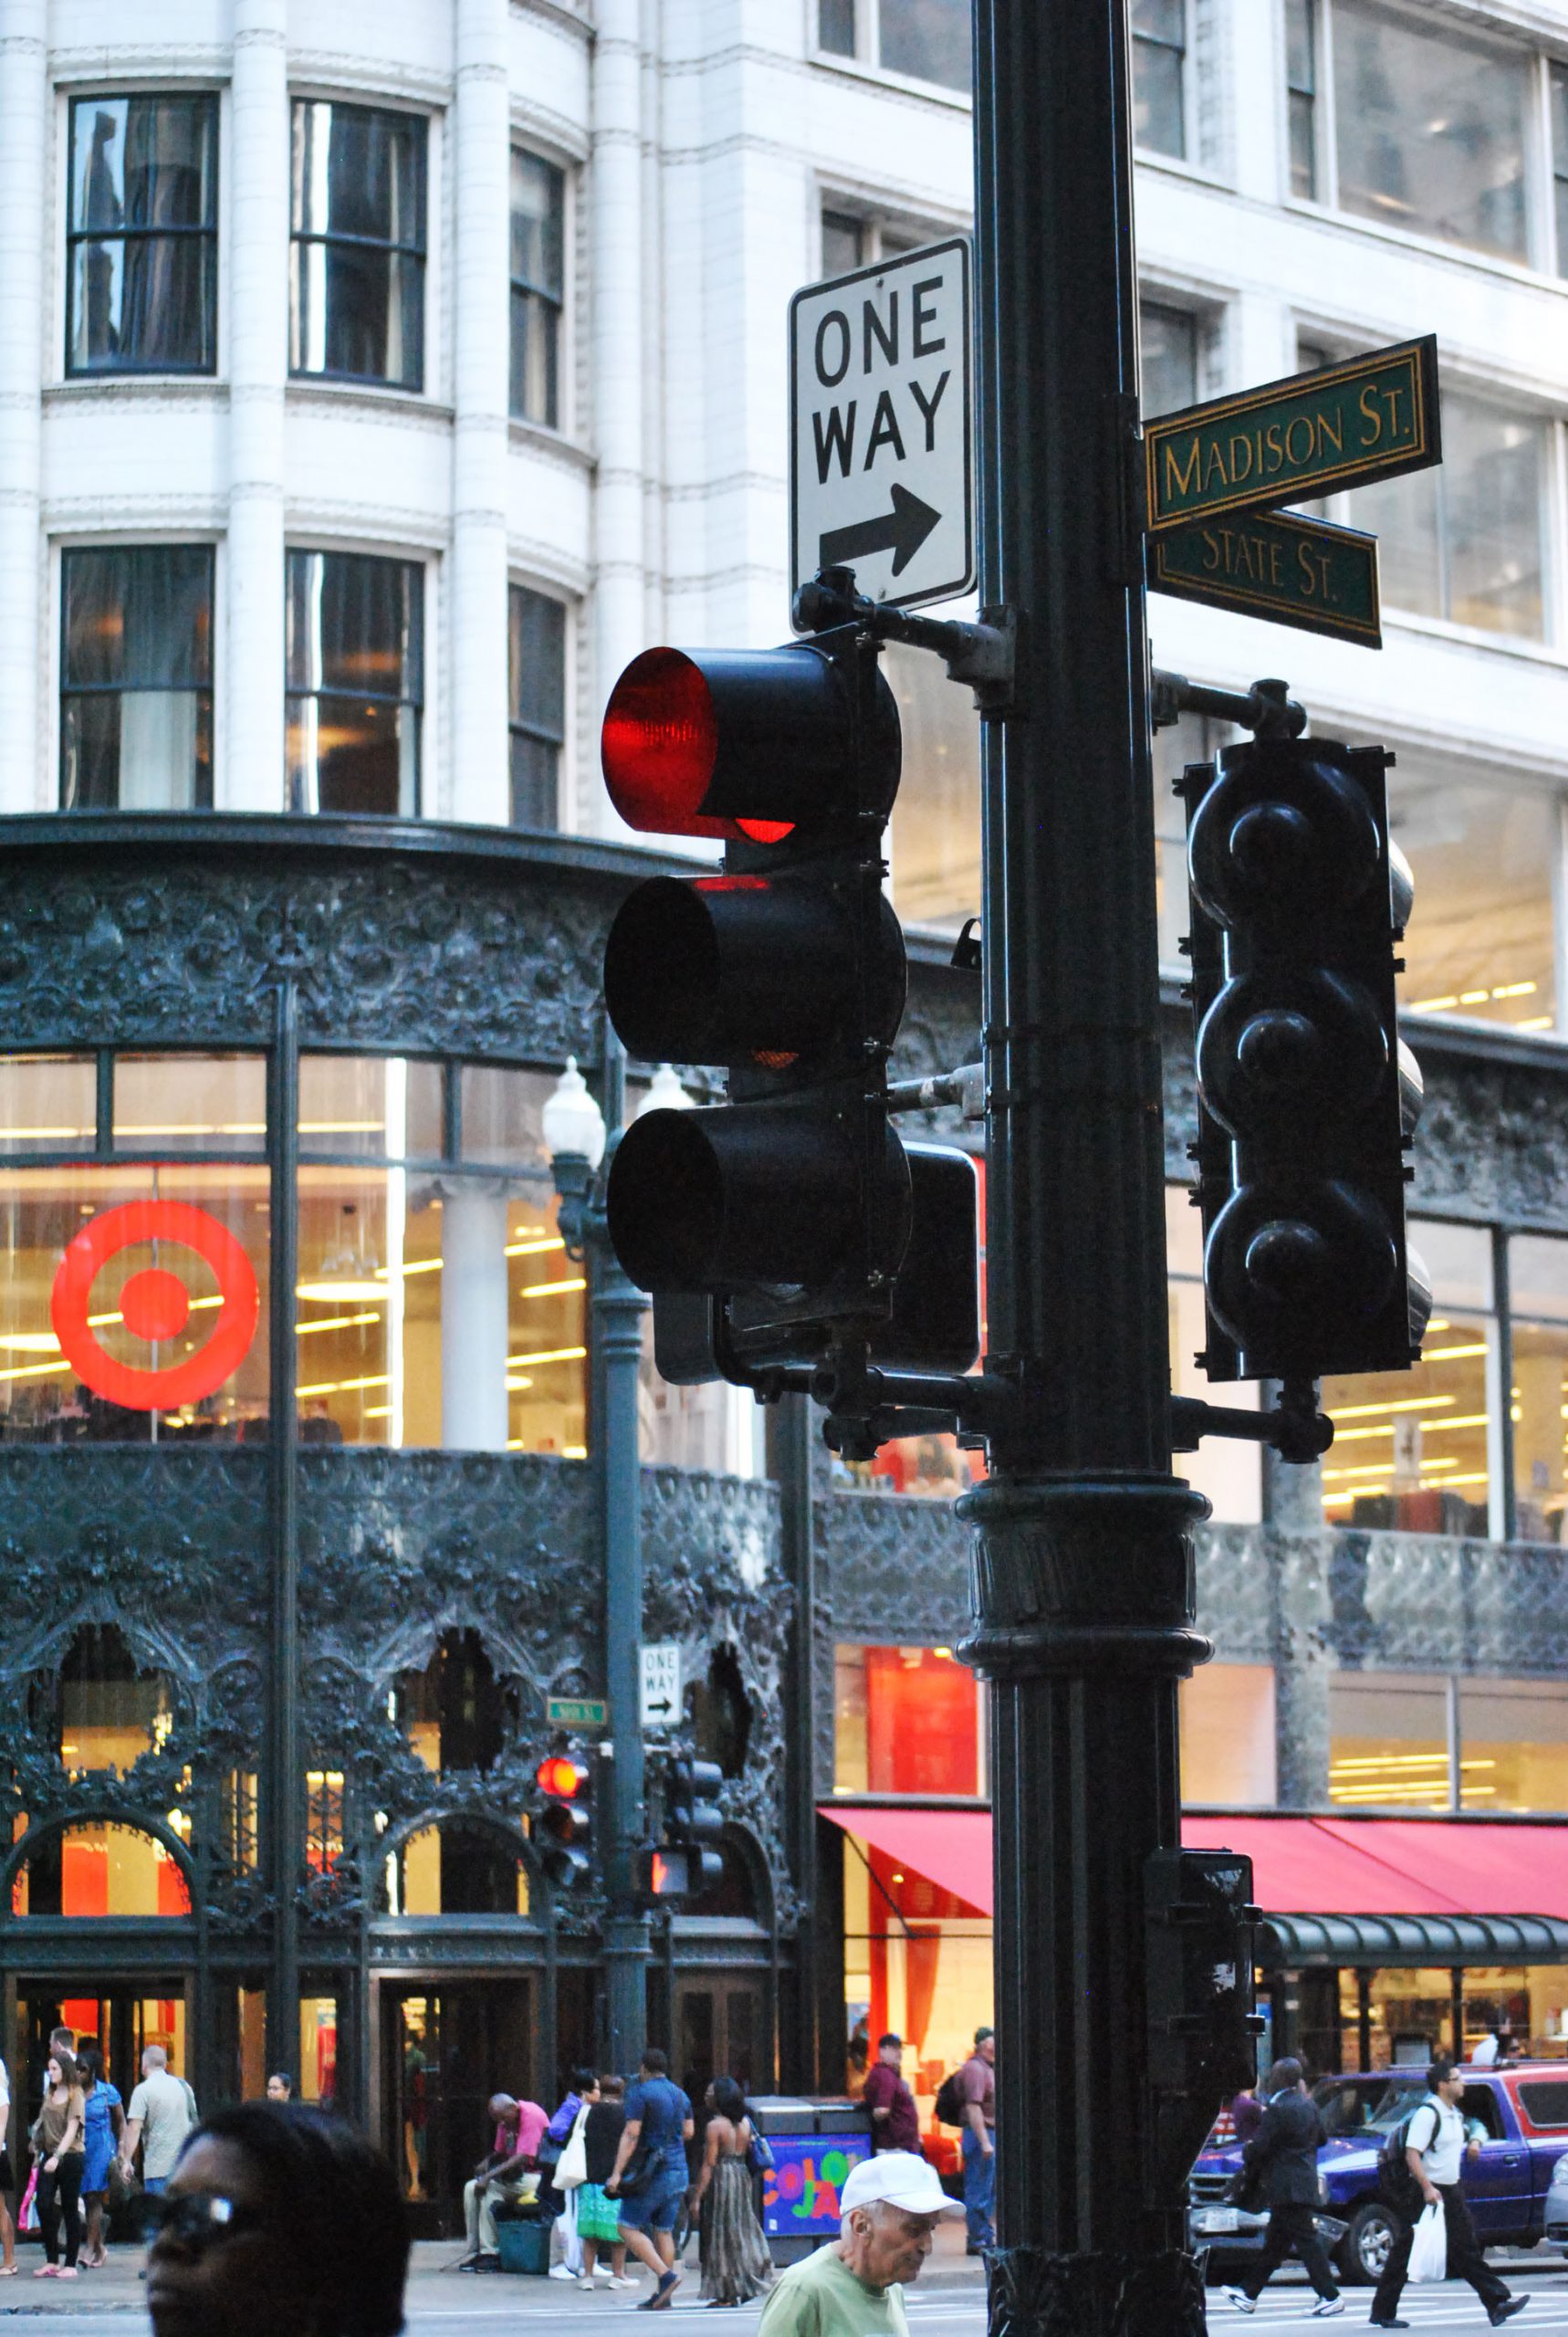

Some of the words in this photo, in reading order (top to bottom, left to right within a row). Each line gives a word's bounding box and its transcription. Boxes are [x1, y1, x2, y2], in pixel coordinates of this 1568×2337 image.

[814, 276, 946, 388] ONE
[811, 369, 951, 486] WAY
[1166, 407, 1343, 501] MADISON
[1202, 529, 1285, 587] STATE
[646, 1651, 674, 1672] ONE
[646, 1673, 675, 1692] WAY
[791, 2180, 842, 2220] JA
